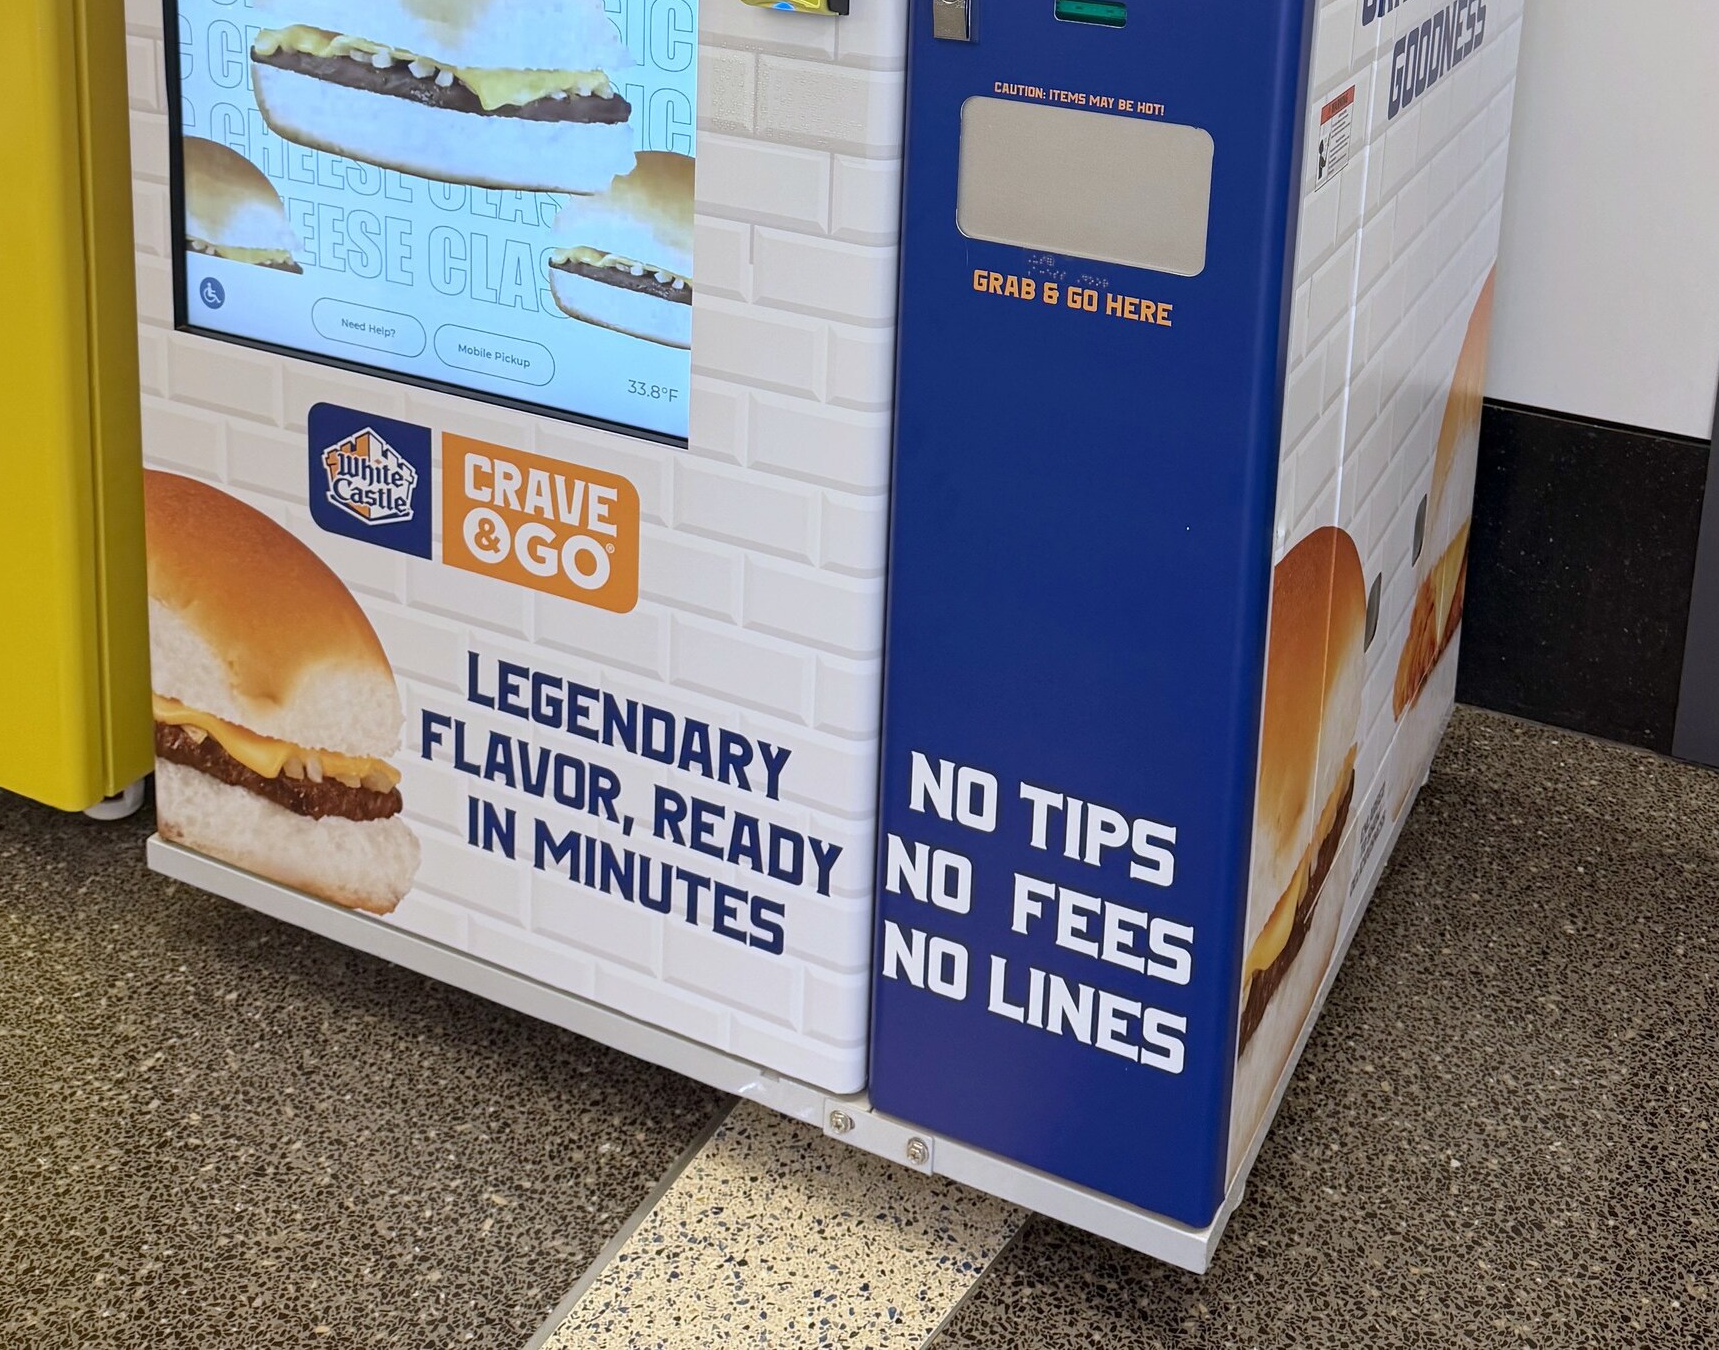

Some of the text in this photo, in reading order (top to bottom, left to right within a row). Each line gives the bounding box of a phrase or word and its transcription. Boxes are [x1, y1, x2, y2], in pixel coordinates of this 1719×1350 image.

[994, 81, 1165, 116] CAUTION: ITEMS MAY BE HOT!
[341, 317, 396, 339] Need Help?
[973, 269, 1036, 300] GRAB
[1043, 282, 1059, 305] &
[1067, 286, 1098, 312] GO
[1106, 293, 1173, 327] HERE
[458, 343, 531, 369] Mobile Pickup
[627, 379, 679, 403] 33.8°F
[333, 478, 407, 513] Castle
[337, 452, 404, 489] White
[464, 452, 618, 538] CRAVE
[466, 650, 792, 801] LEGENDARY
[420, 709, 843, 897] FLAVOR, READY
[909, 750, 1177, 887] NO TIPS
[467, 795, 786, 955] IN MINUTES
[885, 832, 1195, 986] NO FEES
[882, 919, 1187, 1075] NO LINES
